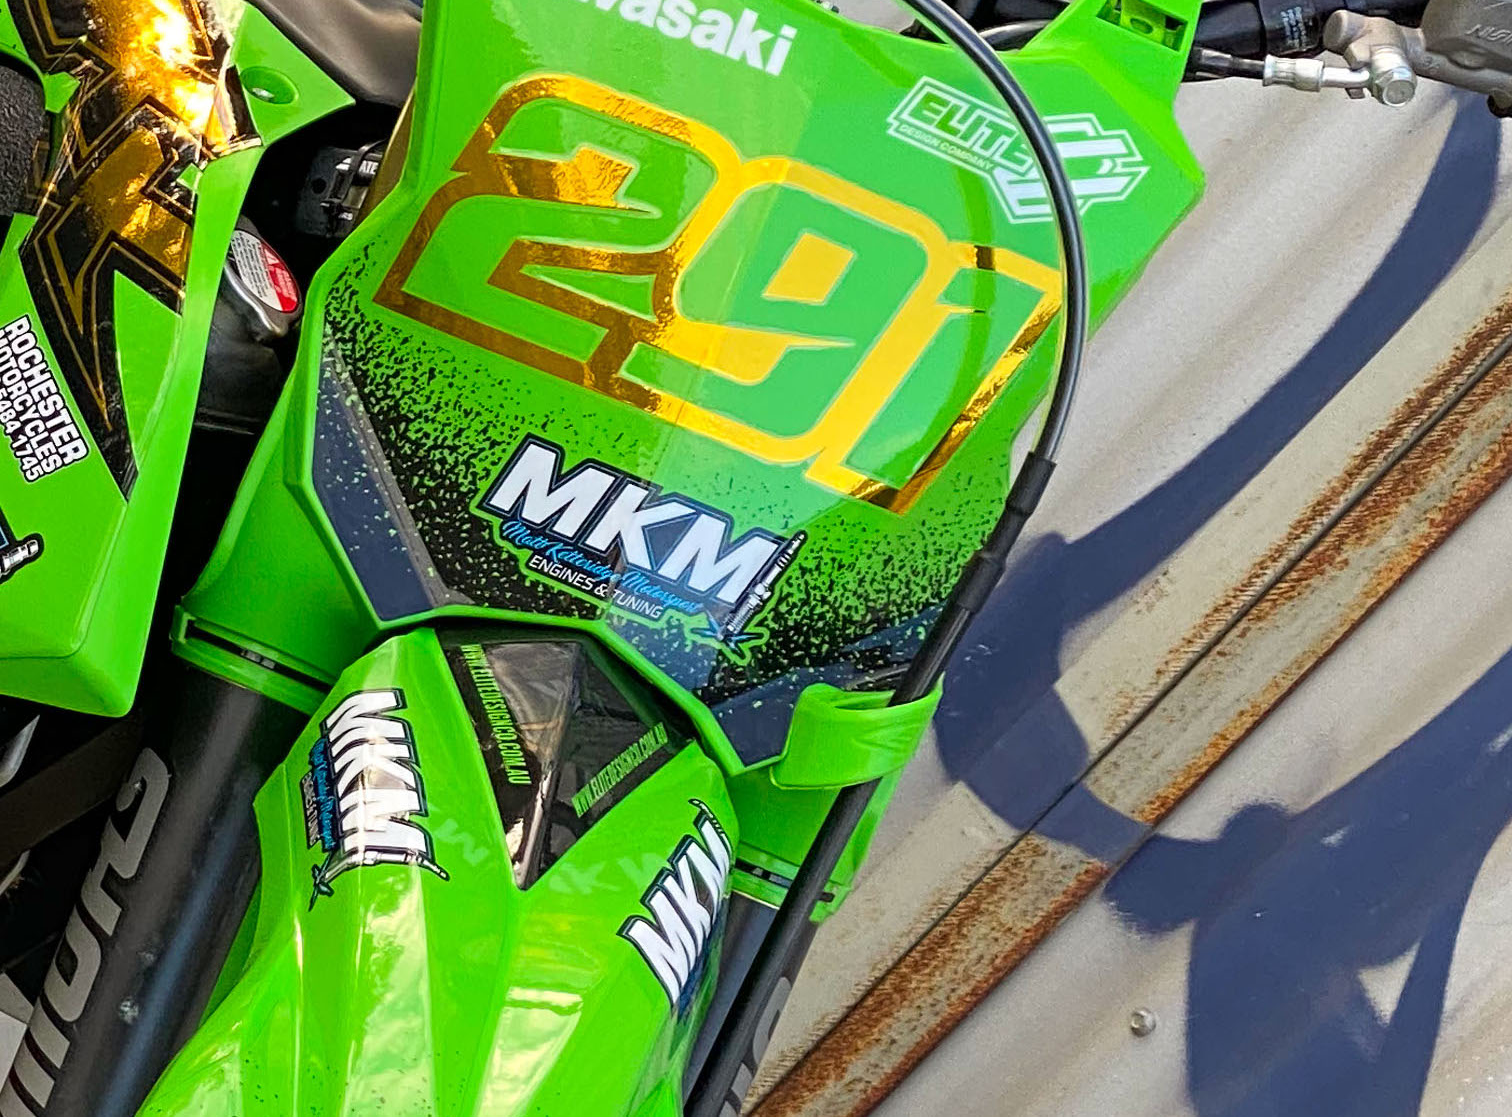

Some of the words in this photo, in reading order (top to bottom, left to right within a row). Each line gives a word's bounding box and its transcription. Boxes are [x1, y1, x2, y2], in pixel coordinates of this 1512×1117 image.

[898, 123, 940, 149] DESIGN
[938, 141, 996, 171] COMPANY
[373, 72, 1064, 517] 291
[5, 316, 89, 466] ROCHESTER
[12, 434, 44, 482] 1745
[488, 442, 780, 605] MKM
[529, 553, 598, 594] ENGINES
[593, 582, 610, 600] &
[611, 588, 664, 620] TUNING
[325, 691, 428, 853] MKM
[460, 643, 532, 785] WWW.ELITEDESIGNCO.COM.AU
[626, 817, 731, 1007] MKM
